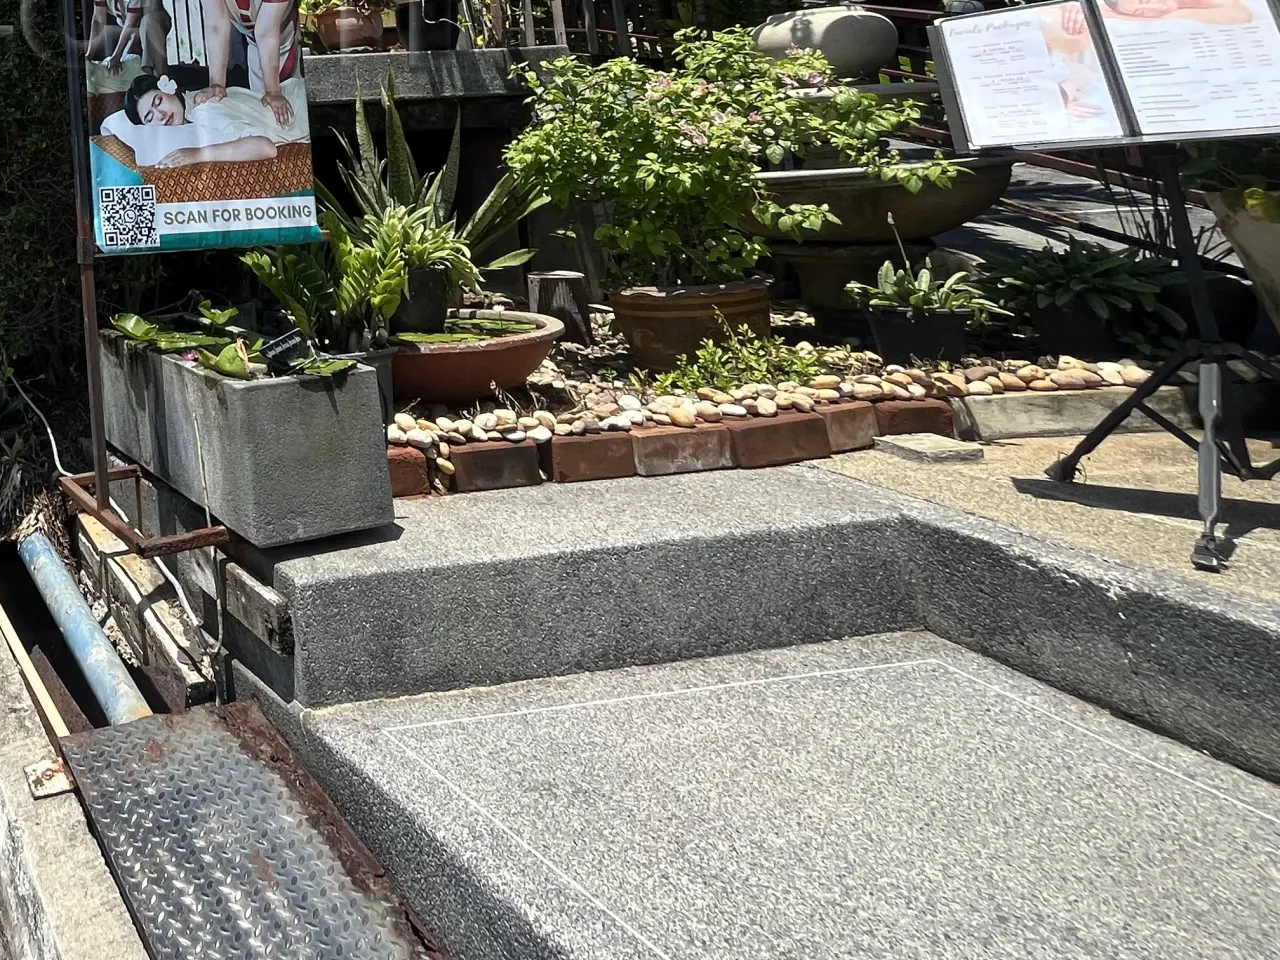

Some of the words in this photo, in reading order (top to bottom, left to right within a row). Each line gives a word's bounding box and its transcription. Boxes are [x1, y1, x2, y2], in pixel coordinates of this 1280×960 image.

[163, 209, 208, 225] SCAN
[212, 208, 242, 223] FOR
[245, 204, 312, 221] BOOKING
